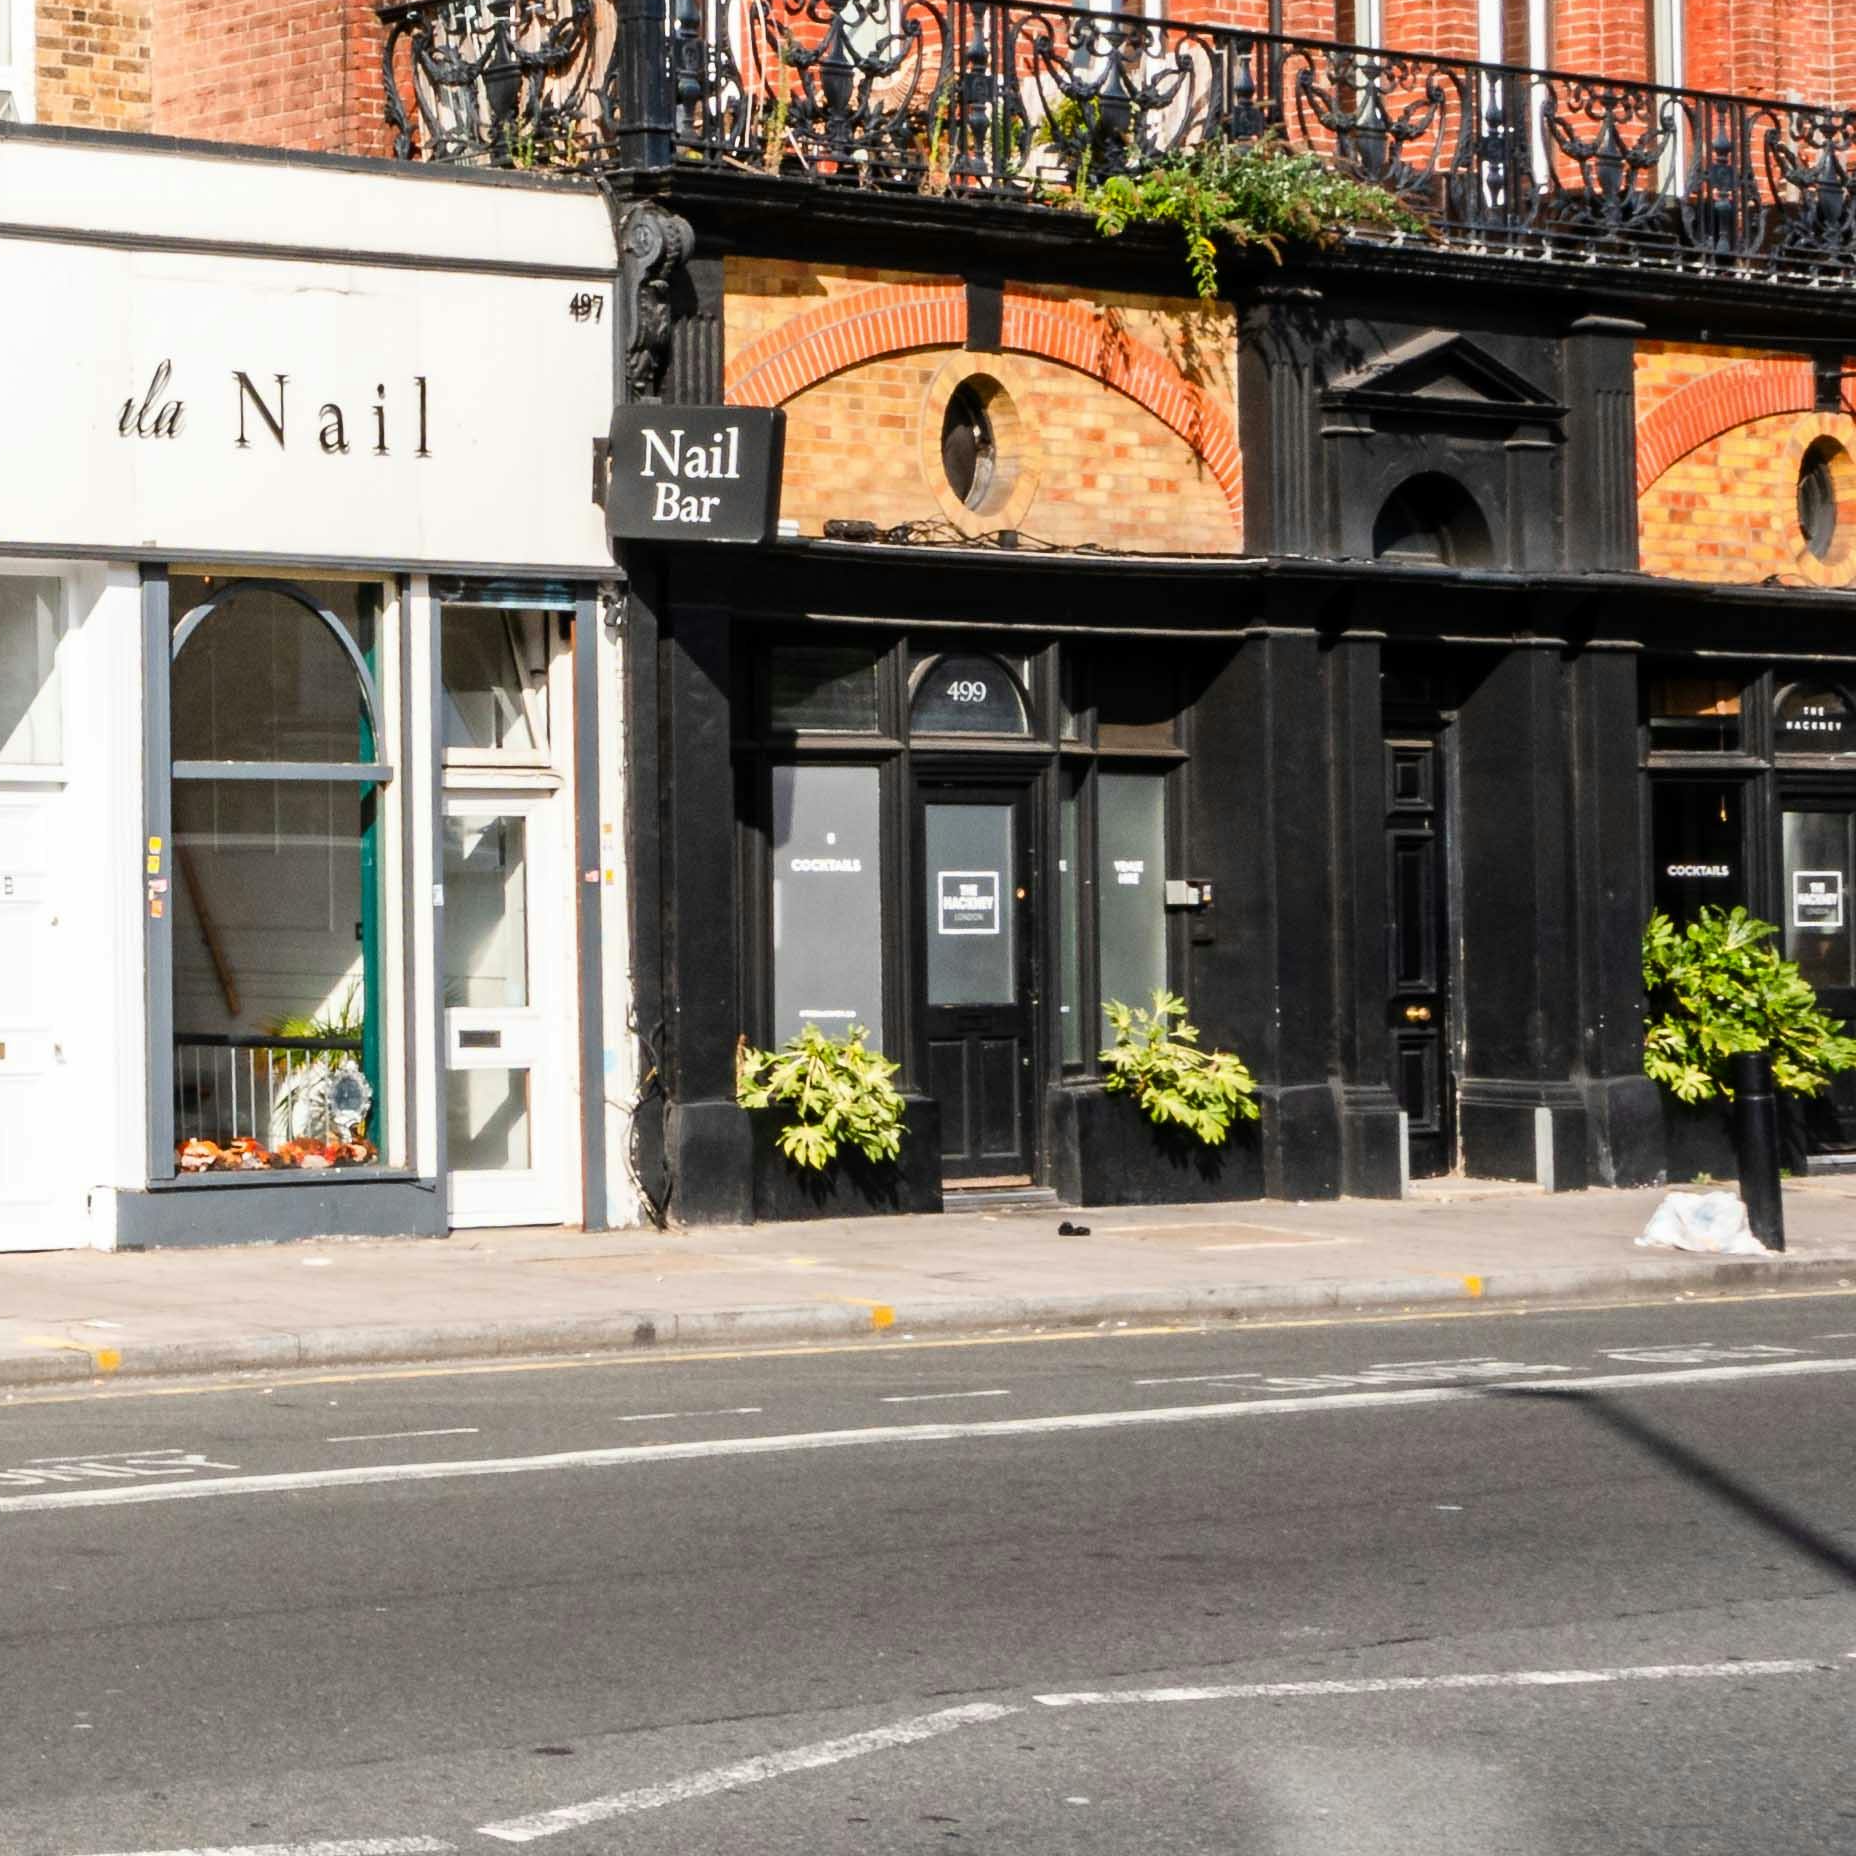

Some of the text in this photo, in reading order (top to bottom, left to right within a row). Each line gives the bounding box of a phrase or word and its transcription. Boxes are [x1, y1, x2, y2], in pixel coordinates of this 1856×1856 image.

[569, 292, 604, 324] 497
[231, 369, 433, 458] Nail
[640, 427, 740, 479] Nail
[652, 482, 721, 523] Bar
[946, 680, 987, 702] 499
[791, 858, 862, 872] COCKTAILS
[1666, 864, 1730, 877] COCKTAILS
[942, 895, 994, 910] HACKNEY
